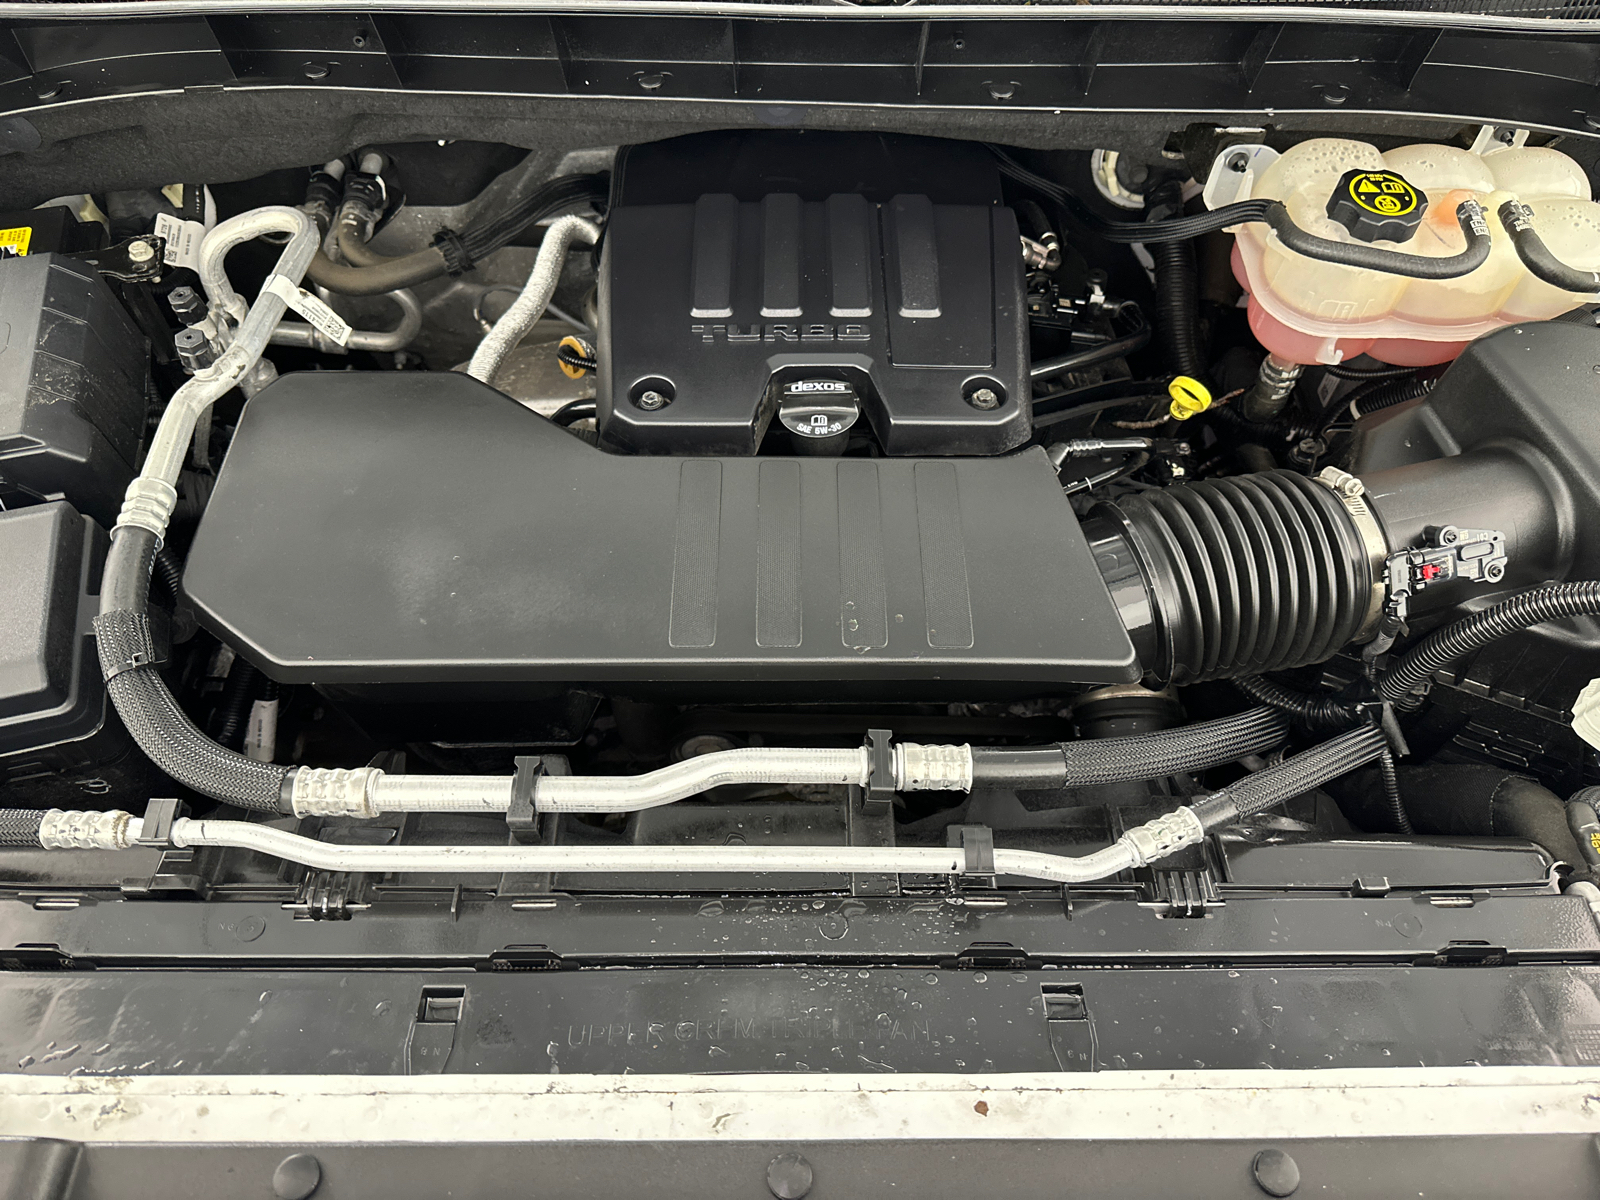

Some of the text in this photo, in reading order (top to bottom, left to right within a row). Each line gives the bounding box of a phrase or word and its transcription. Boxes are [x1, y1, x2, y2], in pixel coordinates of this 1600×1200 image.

[691, 324, 871, 343] TURBO
[790, 380, 846, 393] dexos
[796, 422, 842, 435] SAE 5W-30
